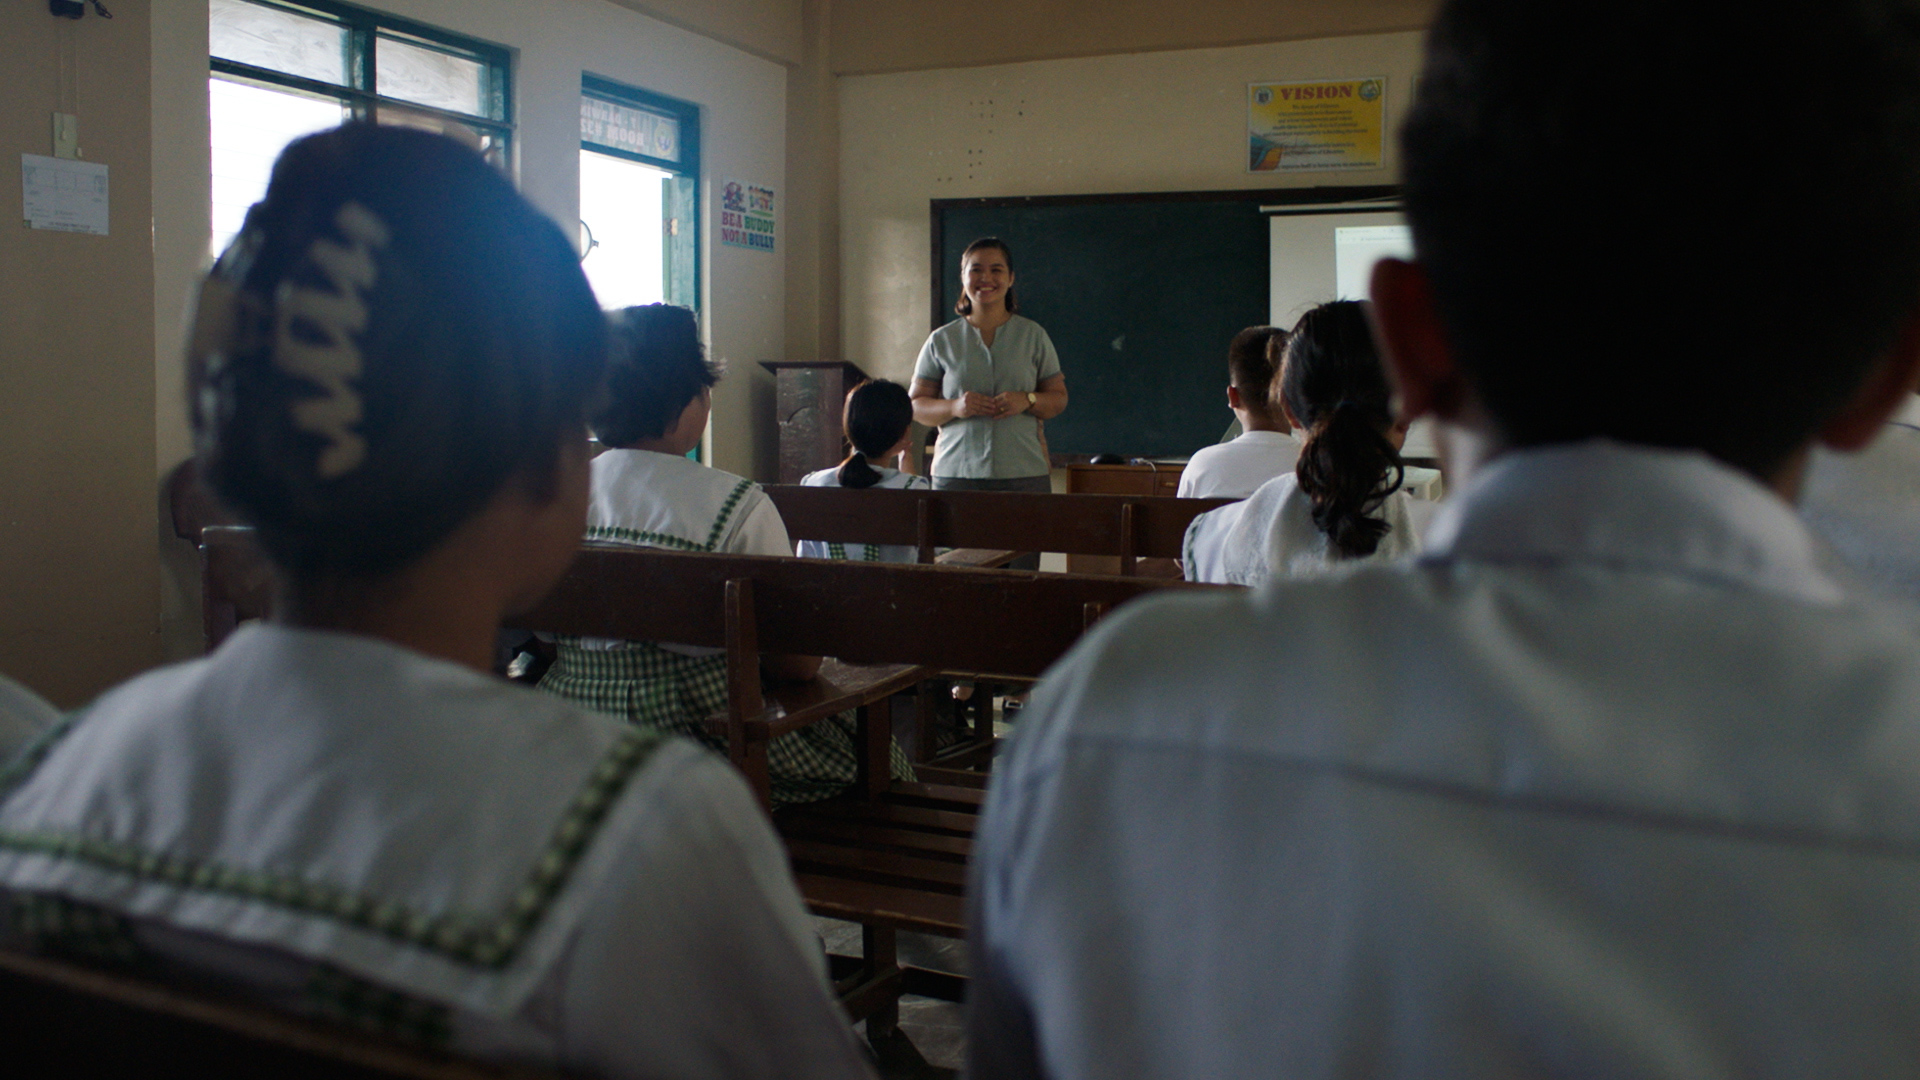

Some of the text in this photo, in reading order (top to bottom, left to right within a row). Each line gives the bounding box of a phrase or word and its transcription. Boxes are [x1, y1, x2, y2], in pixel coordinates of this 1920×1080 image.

[1280, 85, 1353, 100] VISION
[722, 212, 775, 234] BE A BUDDY
[722, 228, 775, 249] NOT A BULLY
